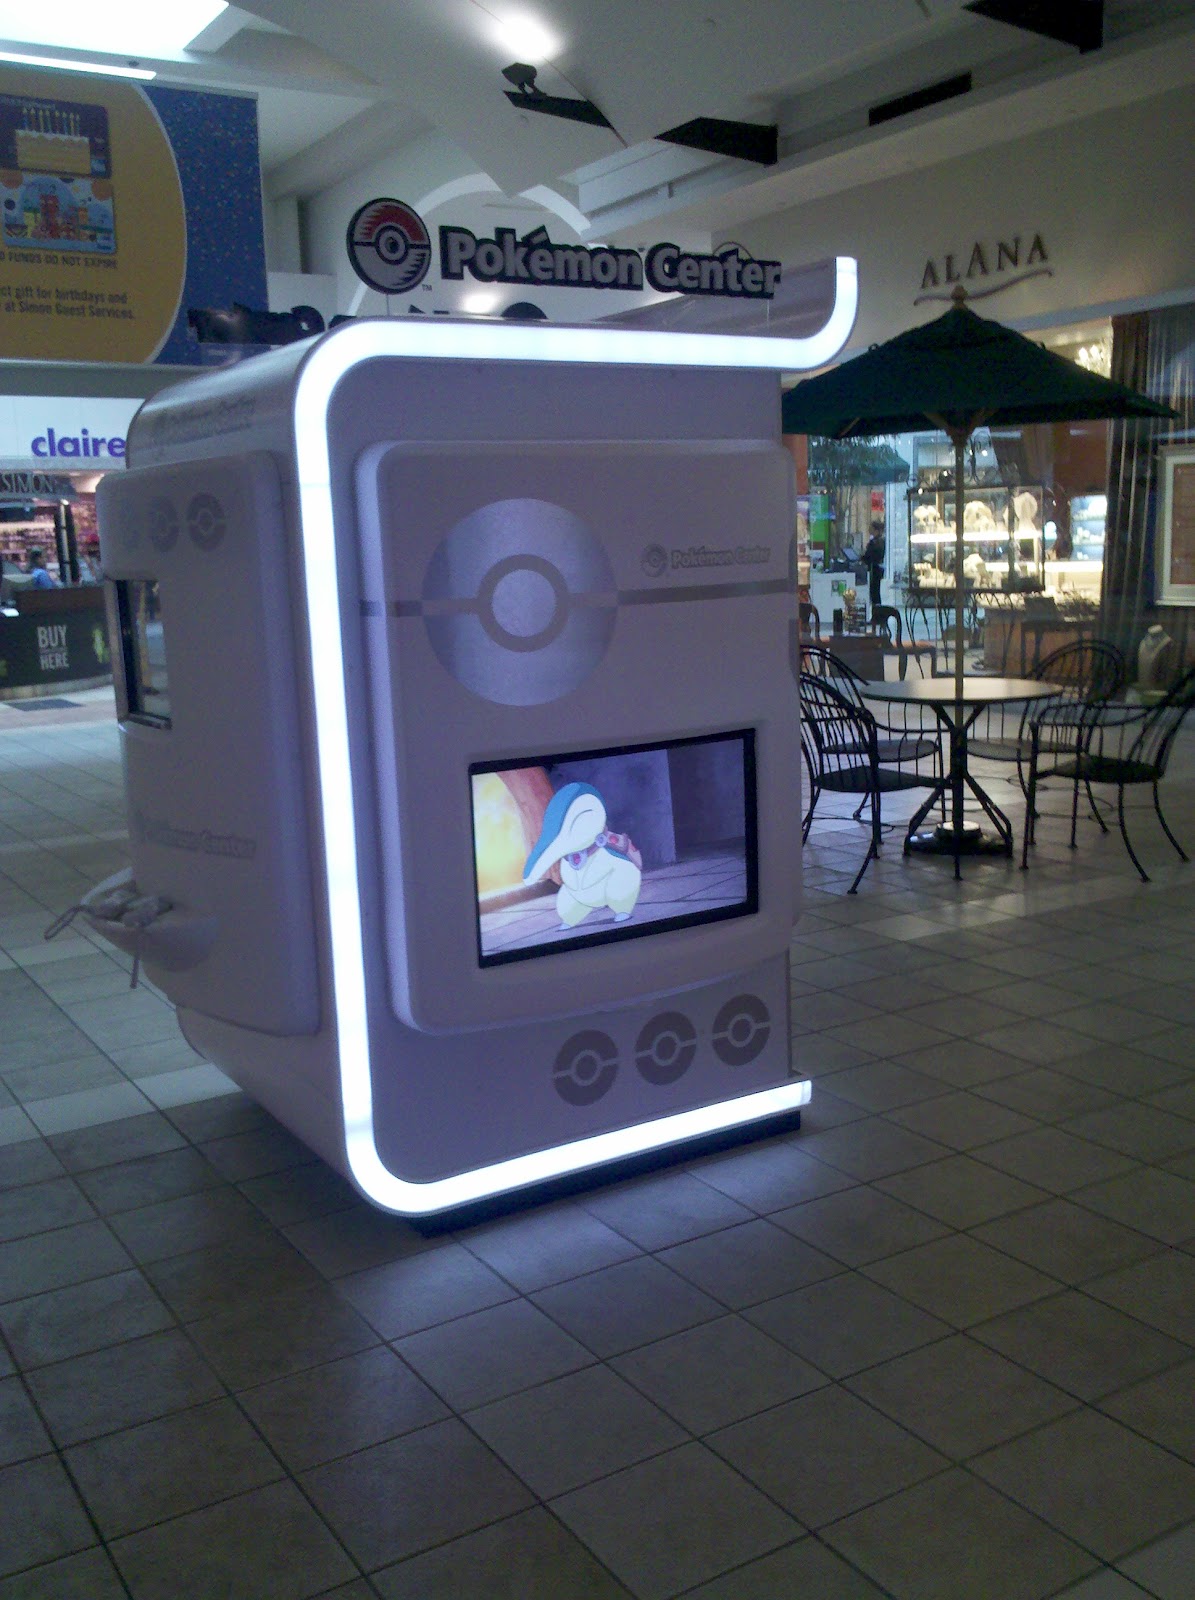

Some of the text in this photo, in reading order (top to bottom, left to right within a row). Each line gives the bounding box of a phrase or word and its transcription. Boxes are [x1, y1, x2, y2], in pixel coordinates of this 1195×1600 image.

[45, 254, 59, 265] DO
[62, 255, 81, 267] NOT
[439, 225, 782, 300] Pokémon Center
[920, 232, 1049, 290] ALANA
[15, 286, 33, 300] gift
[36, 287, 52, 299] for
[55, 288, 106, 305] birthdays
[108, 292, 128, 304] and
[5, 302, 15, 313] at
[19, 301, 52, 314] Simon
[55, 303, 86, 316] Guest
[31, 428, 126, 457] claire
[37, 625, 67, 648] BUY
[40, 652, 70, 671] HERE
